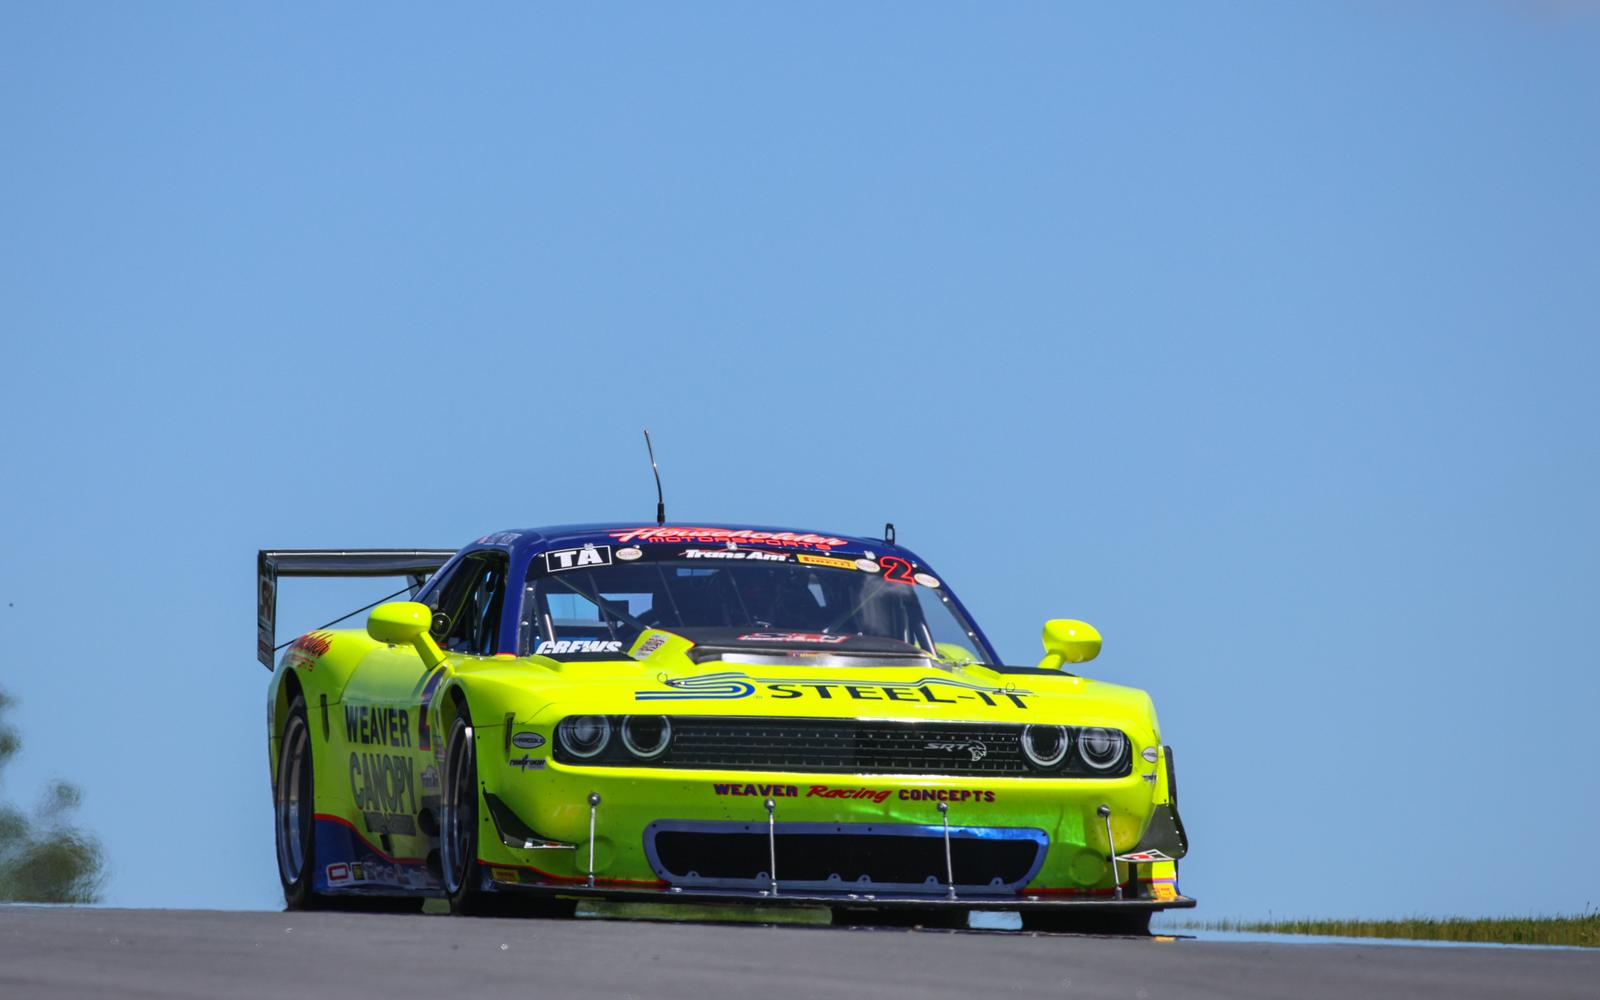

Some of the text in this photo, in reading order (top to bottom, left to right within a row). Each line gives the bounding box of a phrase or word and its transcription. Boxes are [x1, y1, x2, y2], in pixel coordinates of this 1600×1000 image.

[648, 535, 832, 551] MOTORSPORTS
[553, 549, 604, 568] TA
[685, 548, 787, 562] Trans Am
[880, 555, 916, 585] 2
[535, 640, 623, 655] CREWS
[767, 684, 1028, 710] STEEL-IT
[344, 704, 412, 748] WEAVER
[923, 742, 970, 753] SRT
[349, 751, 418, 815] CANOPY
[713, 783, 996, 804] WEAVER Racing CONCEPTS
